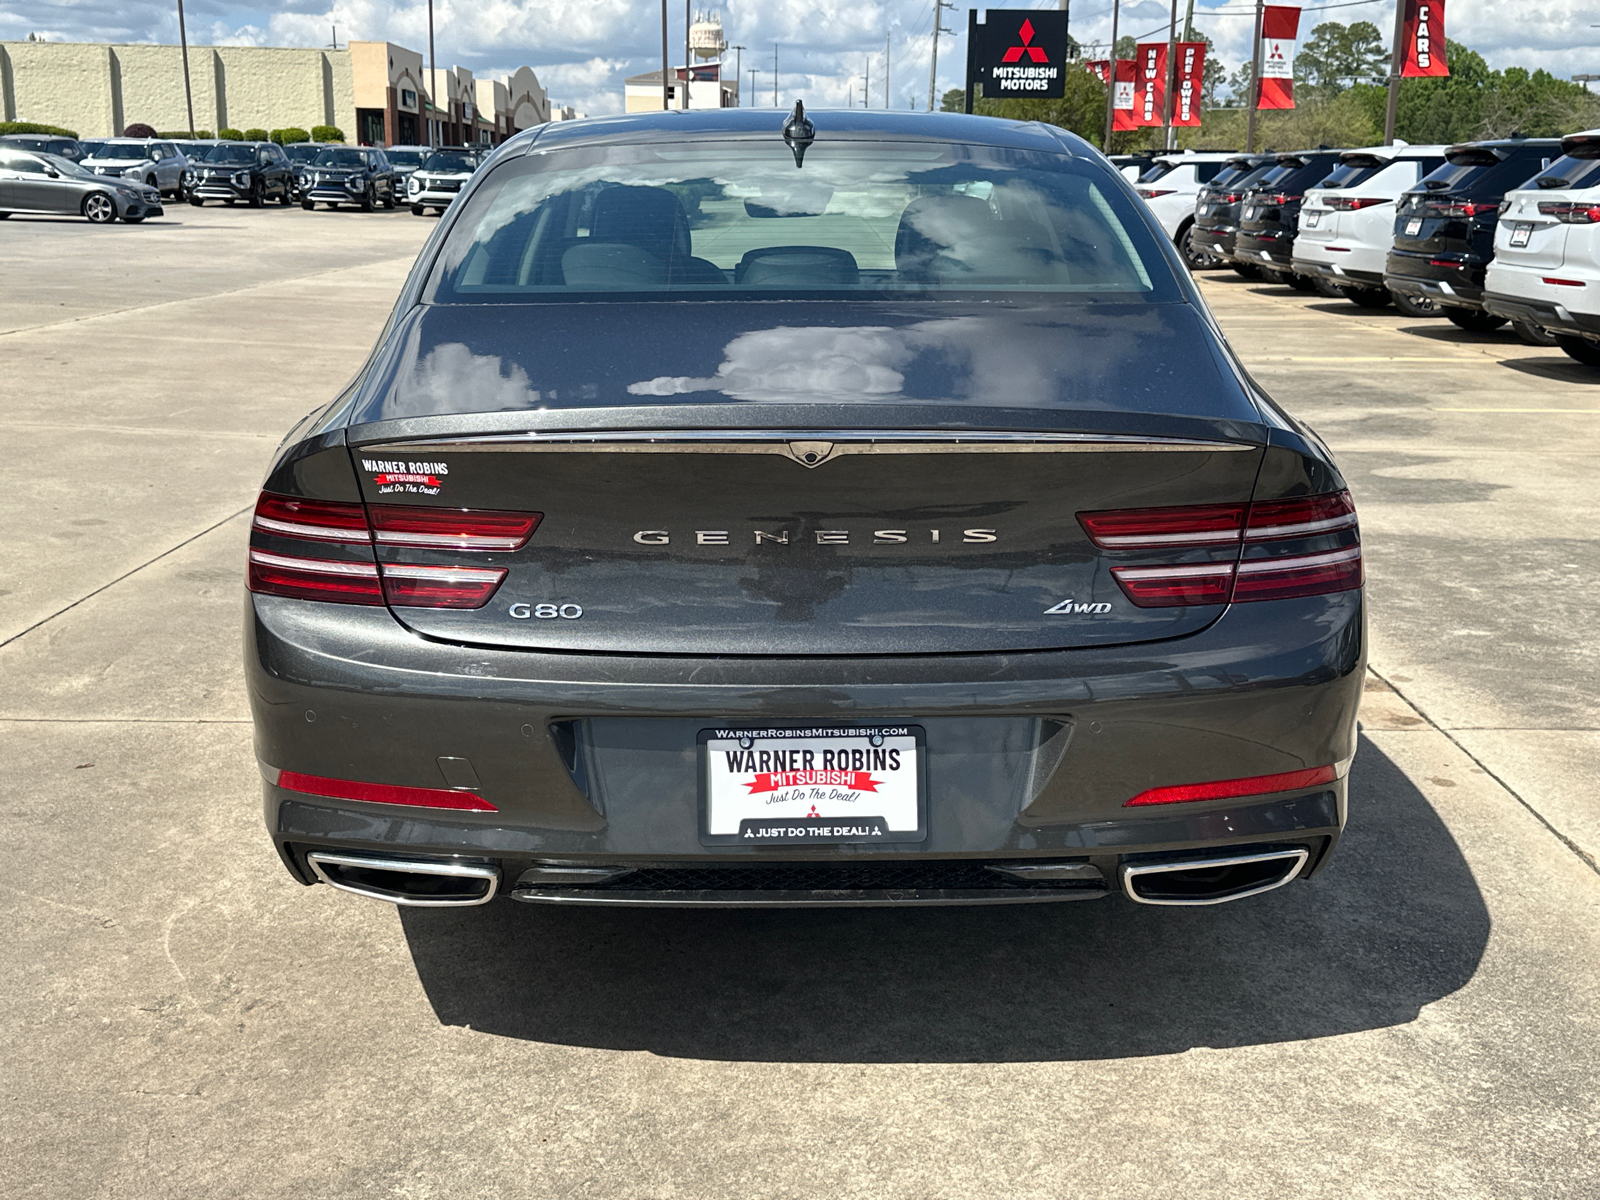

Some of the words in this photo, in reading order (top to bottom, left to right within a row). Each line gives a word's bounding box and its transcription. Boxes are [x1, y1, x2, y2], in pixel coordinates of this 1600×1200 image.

[1417, 6, 1430, 68] CARS
[992, 66, 1058, 78] MITSUBISHI
[1145, 49, 1157, 79] NEW
[1000, 79, 1048, 90] MOTORS
[1180, 48, 1195, 121] PRE-OWNED
[1144, 82, 1154, 121] CARS
[362, 459, 406, 474] WARNER
[408, 462, 448, 474] ROBINS
[386, 474, 428, 483] MITSUBISHI
[379, 485, 394, 494] Just
[394, 484, 404, 492] Do
[406, 484, 418, 492] The
[418, 485, 440, 495] Deal!
[633, 528, 998, 545] GENESIS
[509, 602, 583, 618] G80
[726, 750, 814, 772] WARNER
[823, 748, 900, 771] ROBINS
[770, 771, 855, 786] MITSUBISHI
[766, 791, 789, 804] Just
[792, 788, 805, 800] Do
[809, 788, 826, 800] The
[829, 788, 860, 802] Deal!
[756, 828, 786, 838] JUST
[788, 828, 806, 836] DO
[807, 827, 832, 836] THE
[834, 826, 869, 836] DEAL!
